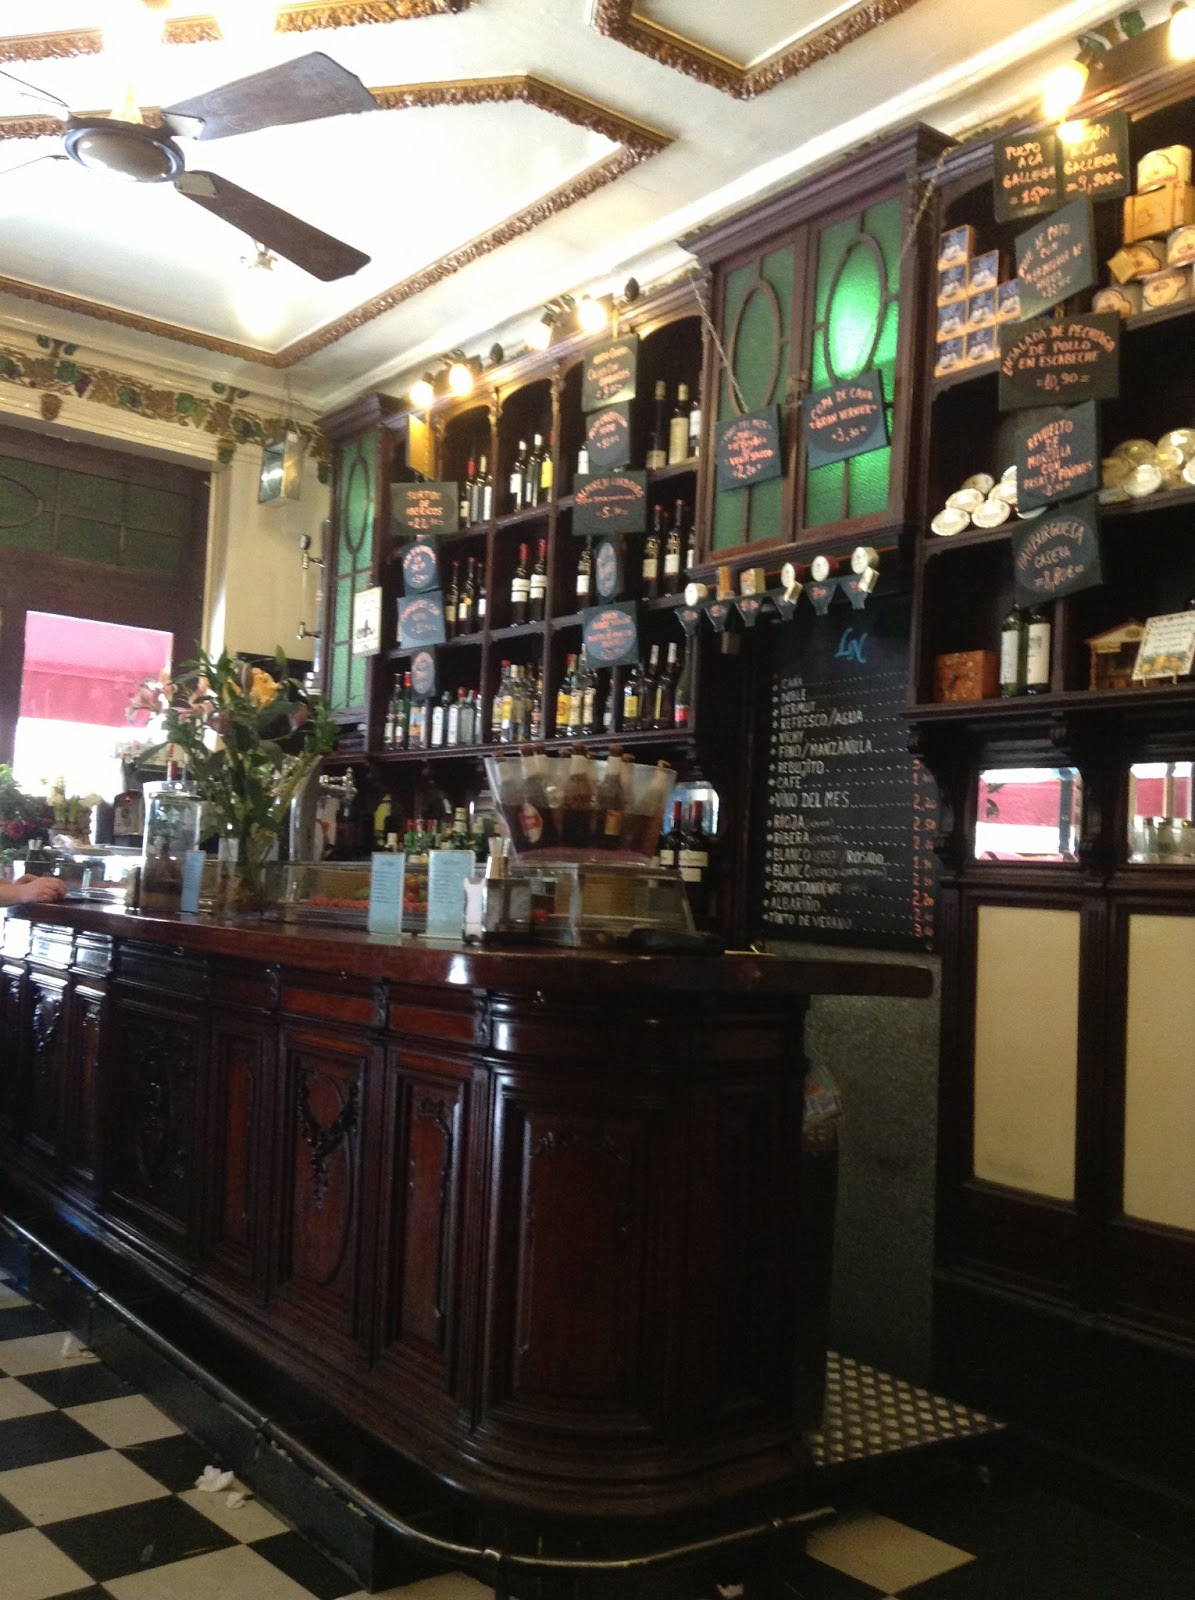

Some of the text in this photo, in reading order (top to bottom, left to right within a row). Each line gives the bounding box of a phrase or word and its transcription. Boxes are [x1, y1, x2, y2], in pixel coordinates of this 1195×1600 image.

[1053, 340, 1091, 354] POLLO
[1018, 356, 1036, 369] EN
[801, 791, 822, 808] DEL
[824, 791, 850, 808] MES
[773, 814, 805, 831] RIOJA
